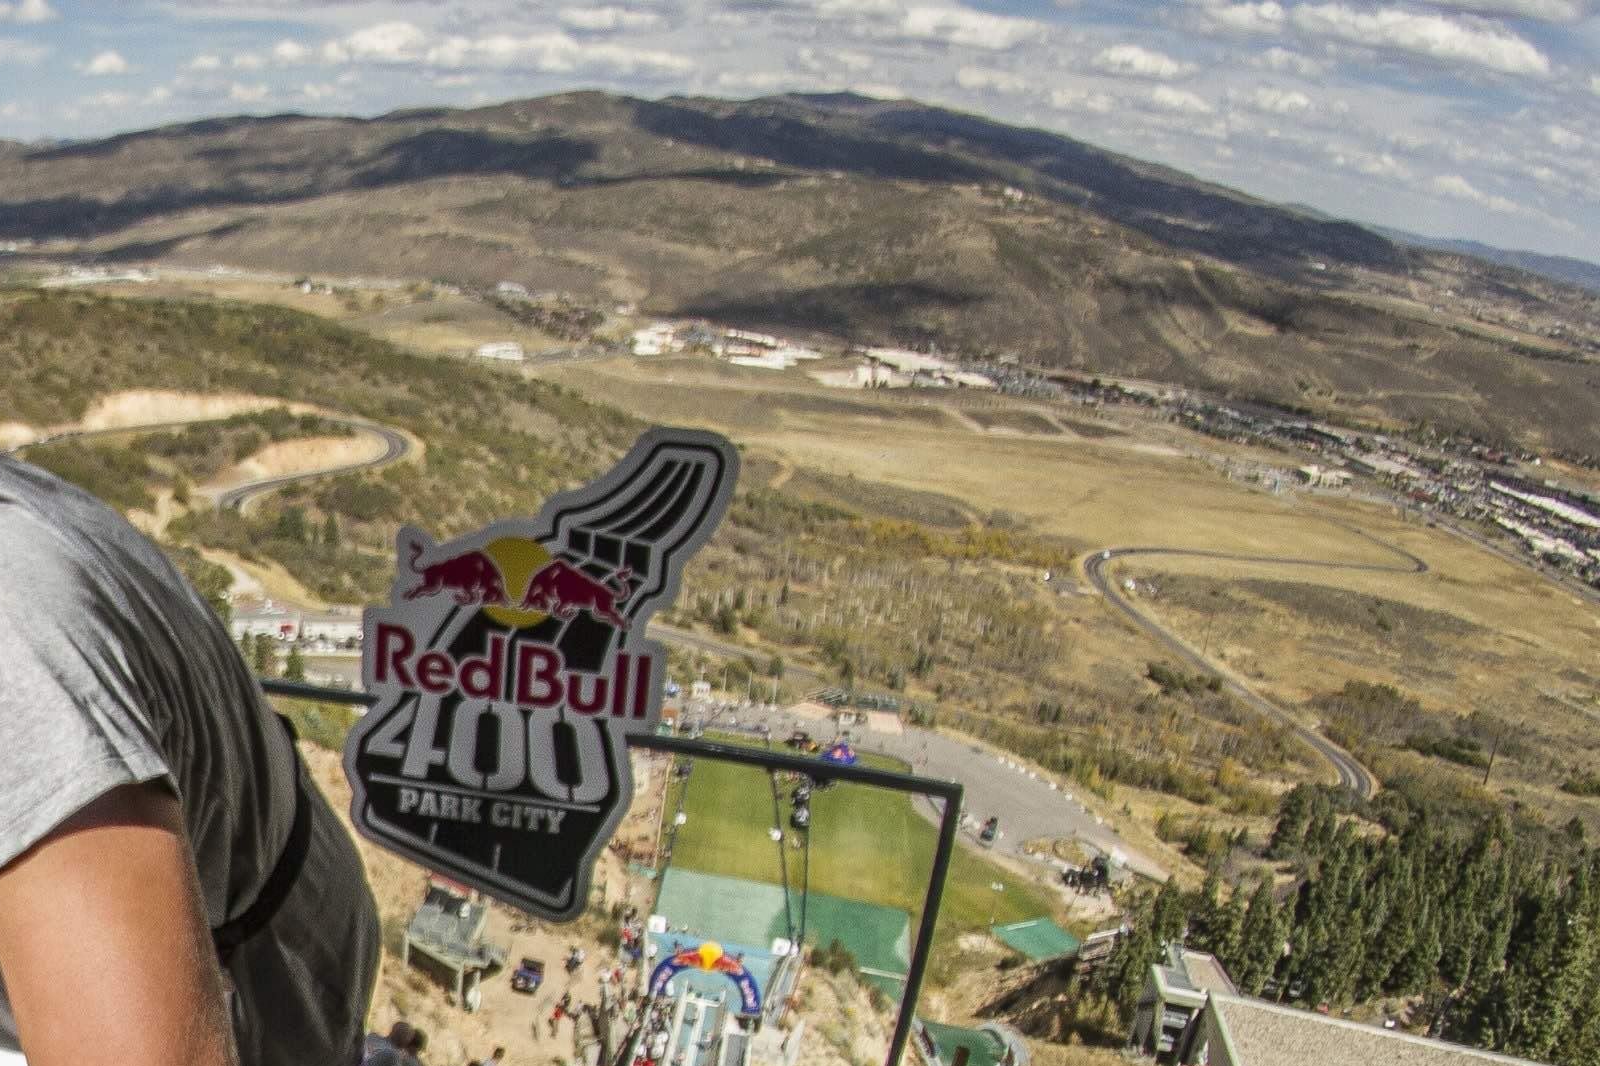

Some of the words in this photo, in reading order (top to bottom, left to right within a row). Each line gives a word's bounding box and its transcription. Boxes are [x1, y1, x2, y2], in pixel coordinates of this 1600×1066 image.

[365, 693, 611, 803] 400
[399, 788, 482, 824] PARK
[490, 800, 568, 835] CITY
